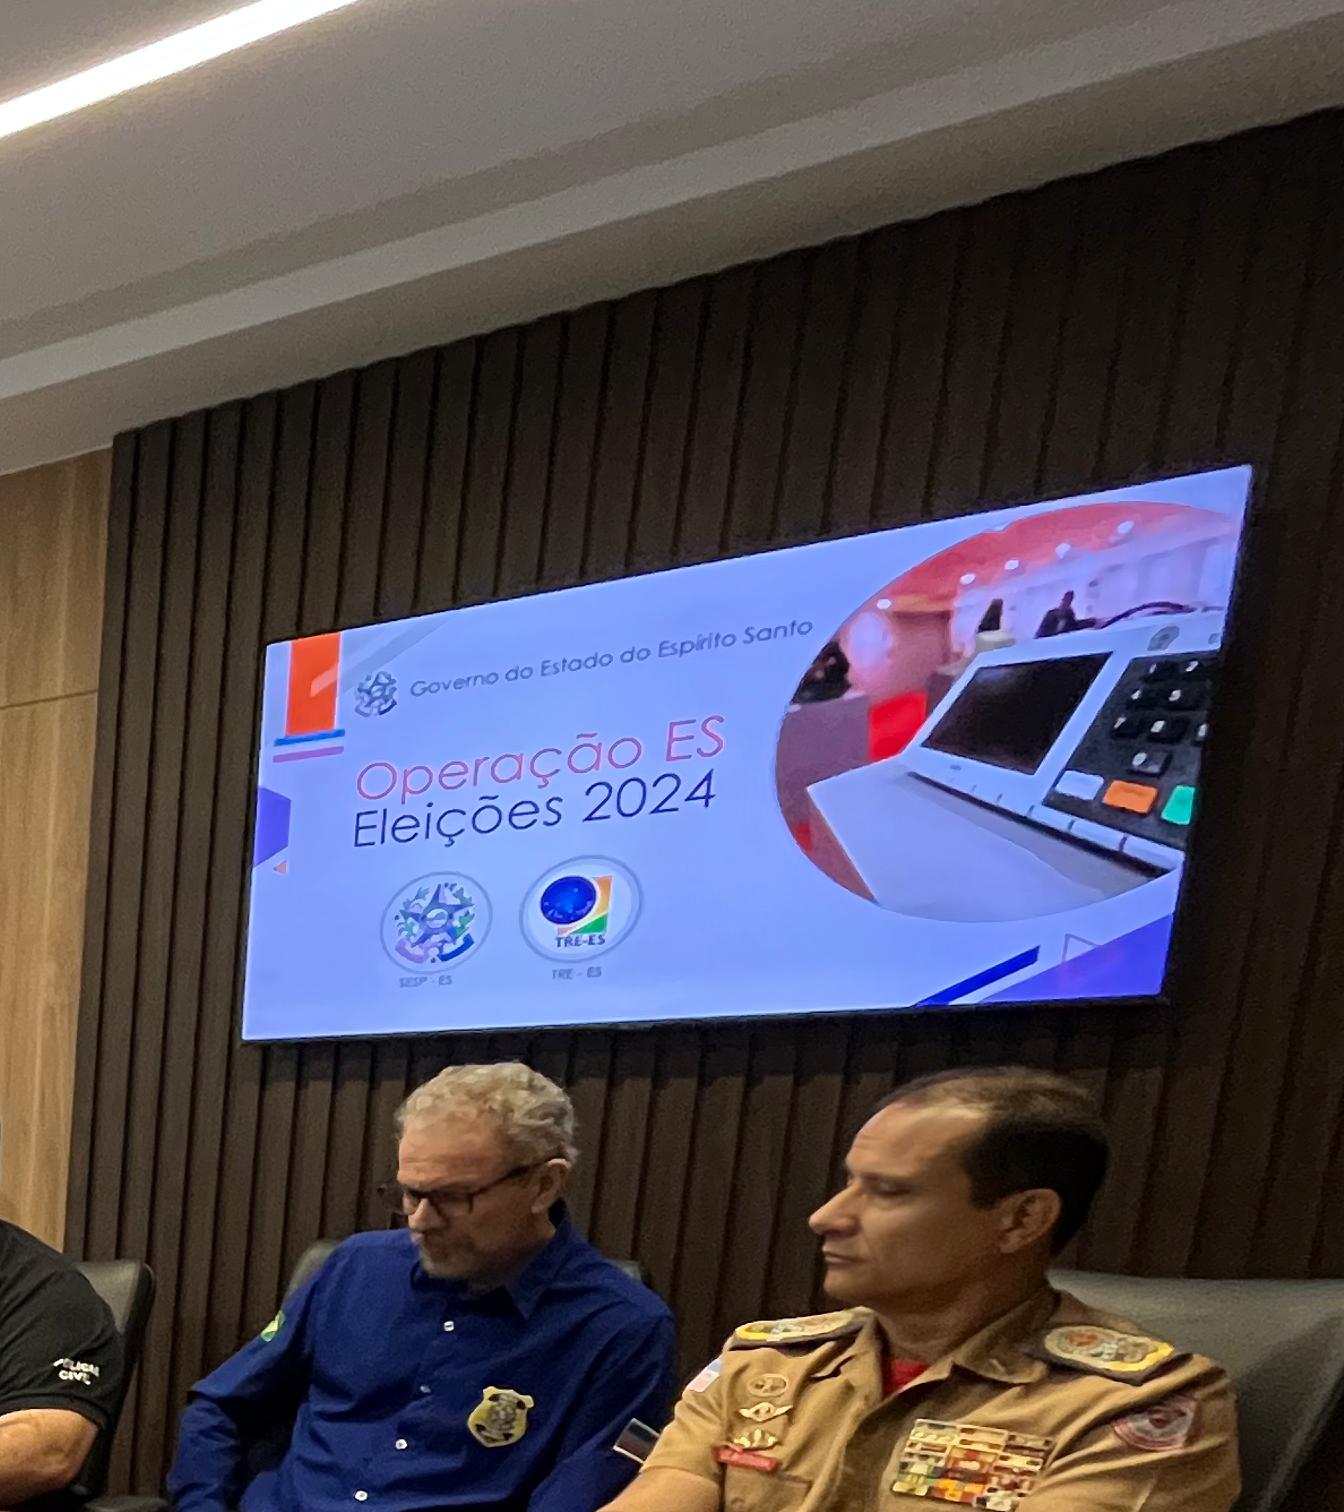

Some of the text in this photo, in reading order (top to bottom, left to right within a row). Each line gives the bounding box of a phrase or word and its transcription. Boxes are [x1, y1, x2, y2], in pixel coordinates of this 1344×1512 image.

[410, 672, 499, 697] Governo
[505, 665, 534, 682] do
[540, 652, 613, 677] Estado
[620, 646, 651, 663] do
[743, 620, 813, 644] Santo
[356, 714, 725, 804] Operação ES
[354, 768, 716, 847] Eleições 2024
[555, 934, 606, 948] TRE-ES
